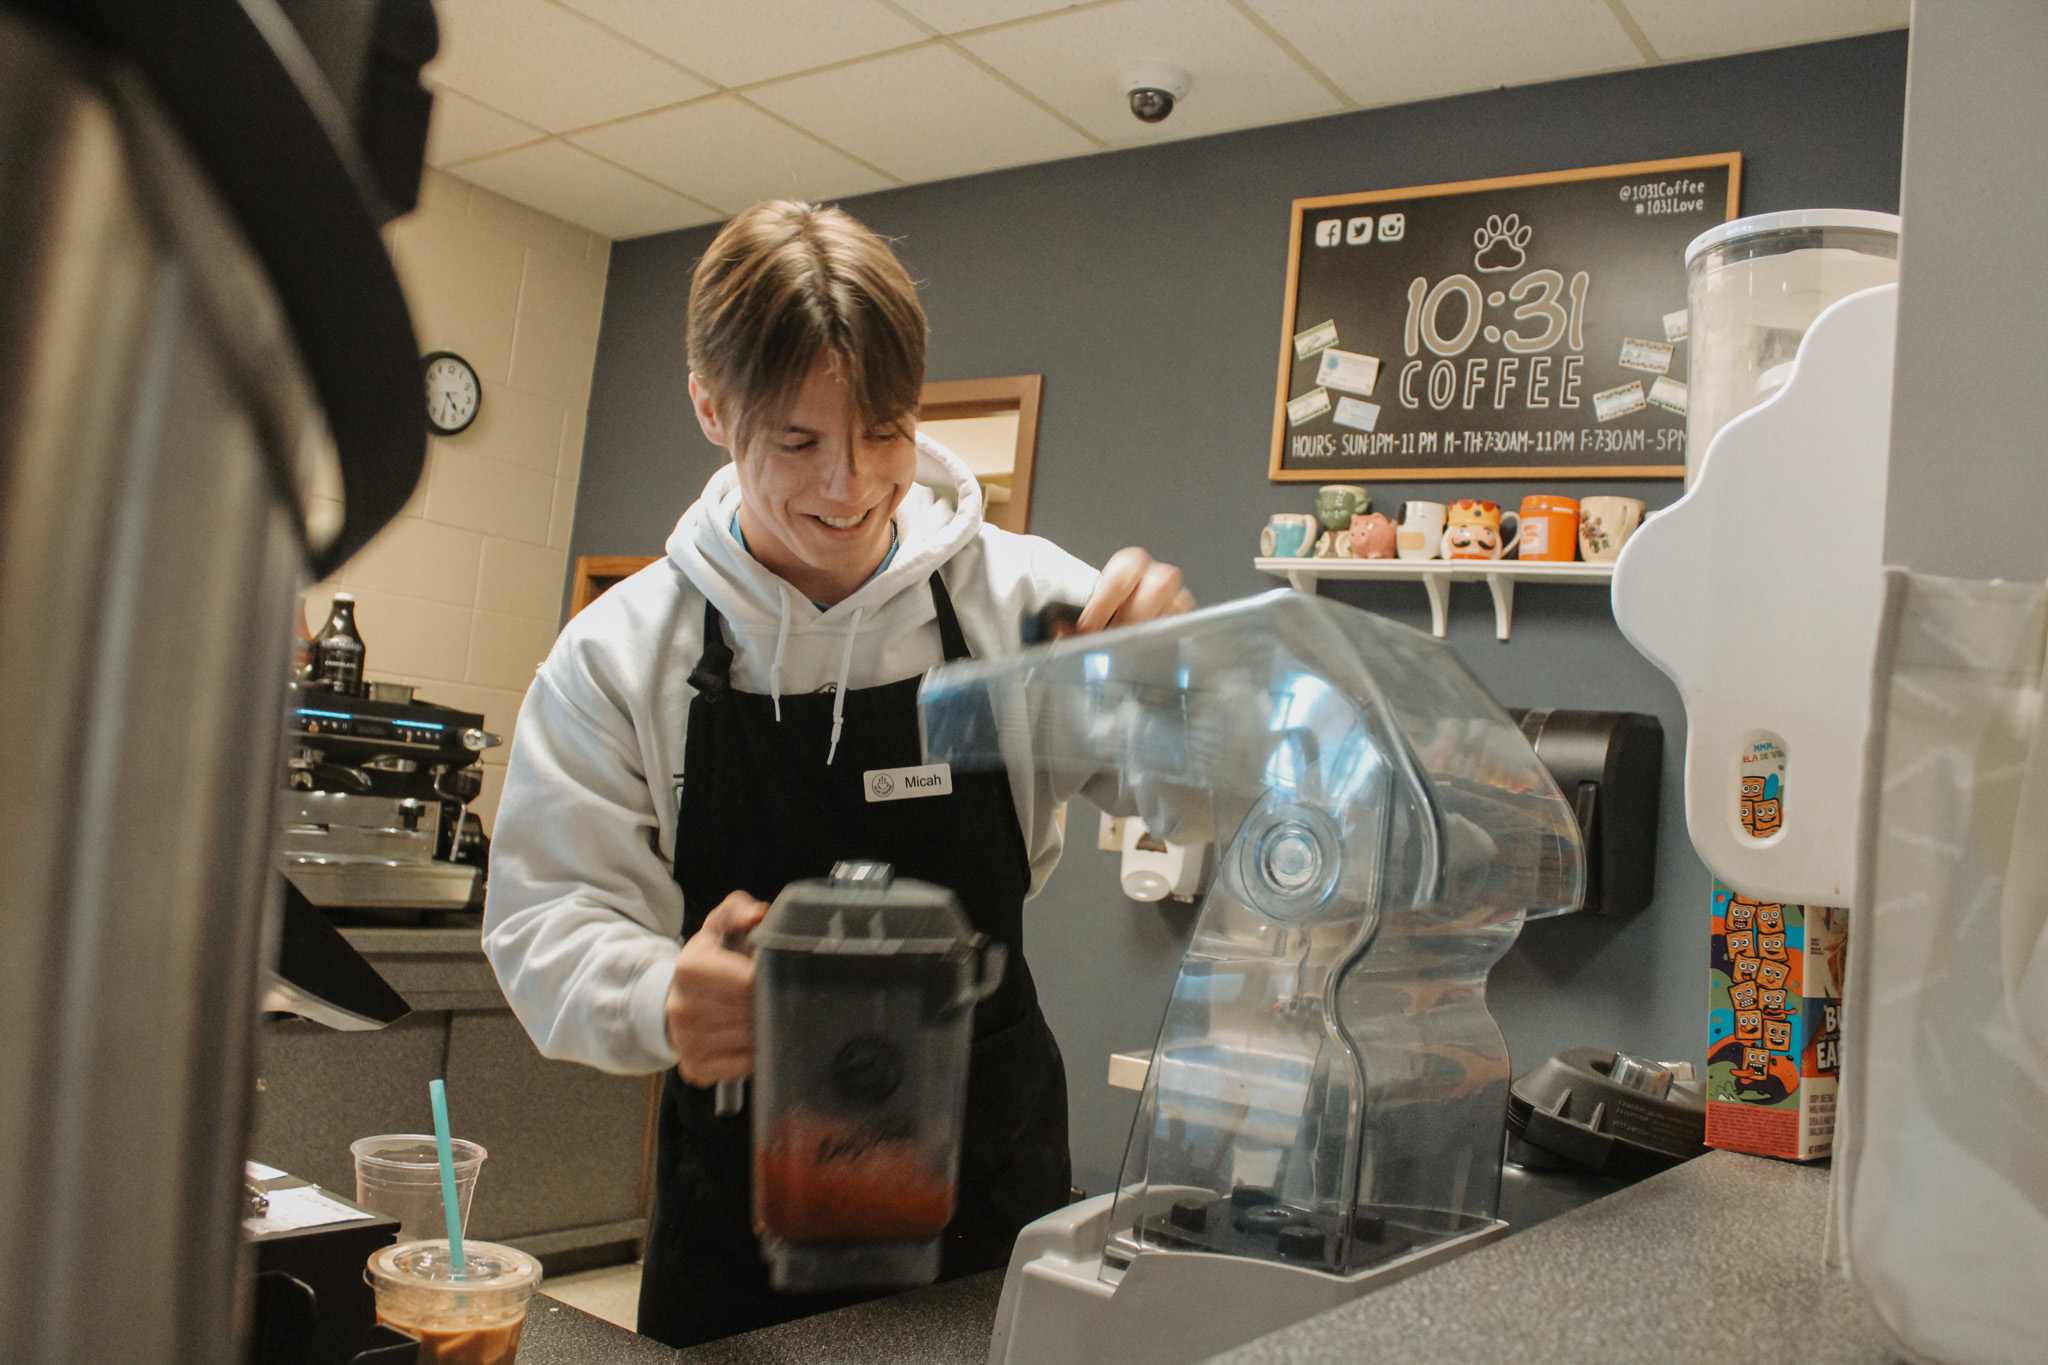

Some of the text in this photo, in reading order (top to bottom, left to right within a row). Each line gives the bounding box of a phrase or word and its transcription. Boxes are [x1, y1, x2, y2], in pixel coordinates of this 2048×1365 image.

[1620, 179, 1705, 201] @1031Coffee
[1405, 268, 1590, 357] 10:31
[1399, 355, 1585, 411] COFFEE
[1292, 434, 1337, 458] HOURS:
[905, 774, 942, 789] Micah
